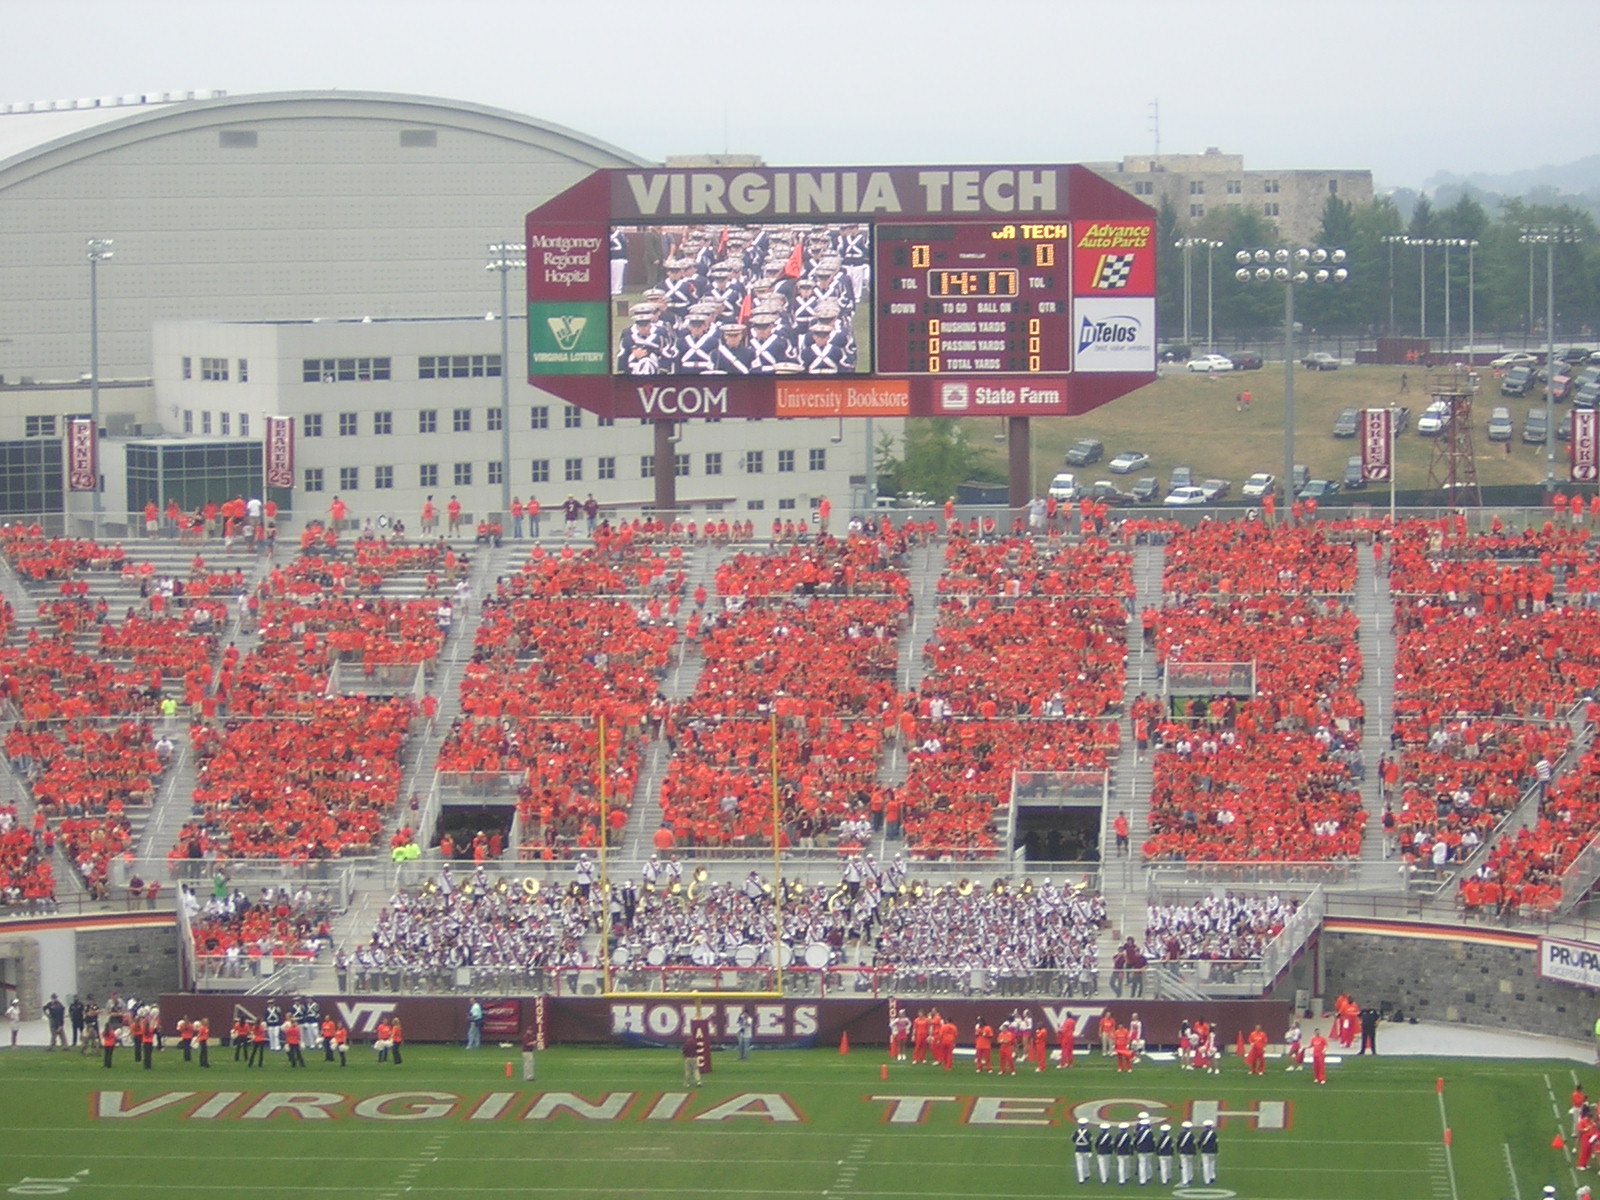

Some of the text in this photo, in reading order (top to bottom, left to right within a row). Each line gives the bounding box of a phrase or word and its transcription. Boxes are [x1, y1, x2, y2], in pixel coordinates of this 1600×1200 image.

[627, 170, 1057, 214] VIRGINIA TECH
[1020, 225, 1067, 238] TECH
[1085, 224, 1150, 237] Advance
[532, 235, 601, 252] Montgomery
[1078, 237, 1147, 248] Auto Parts
[544, 252, 590, 269] Regional
[912, 245, 930, 268] 0
[1036, 244, 1054, 266] 0
[545, 269, 589, 286] Hospital
[901, 278, 917, 289] TOL
[941, 272, 1015, 295] 14:17
[1029, 277, 1045, 288] TOL
[891, 304, 916, 314] DOWN
[943, 303, 967, 313] TO GO
[977, 303, 998, 313] BALL
[1038, 302, 1056, 313] QTR
[929, 319, 940, 336] 0
[941, 322, 1006, 332] RUSHING YARDS
[1029, 318, 1040, 335] 0
[1081, 322, 1136, 343] nTelos
[929, 338, 940, 354] 0
[941, 340, 1005, 351] PASSING YARDS
[1029, 337, 1040, 353] 0
[533, 352, 604, 362] VIRGINIA LOTTERY
[929, 356, 940, 372] 0
[947, 359, 1000, 369] TOTAL YARDS
[1029, 355, 1040, 371] 0
[637, 386, 728, 413] VCOM
[777, 388, 909, 412] University Bookstore
[975, 386, 1061, 404] State Farm
[275, 421, 286, 469] BEAMER
[1371, 413, 1381, 463] HOKIES
[1580, 415, 1590, 460] VICK
[77, 425, 88, 469] PYNE
[72, 472, 93, 488] 73
[270, 470, 290, 486] 25
[1579, 465, 1591, 479] 7
[337, 1002, 399, 1033] VT
[534, 996, 545, 1051] HOKIES
[612, 1005, 818, 1035] HOKIES
[1042, 1007, 1105, 1037] VT
[695, 1027, 705, 1067] ACC
[96, 1091, 1290, 1129] VIRGINIA TECH
